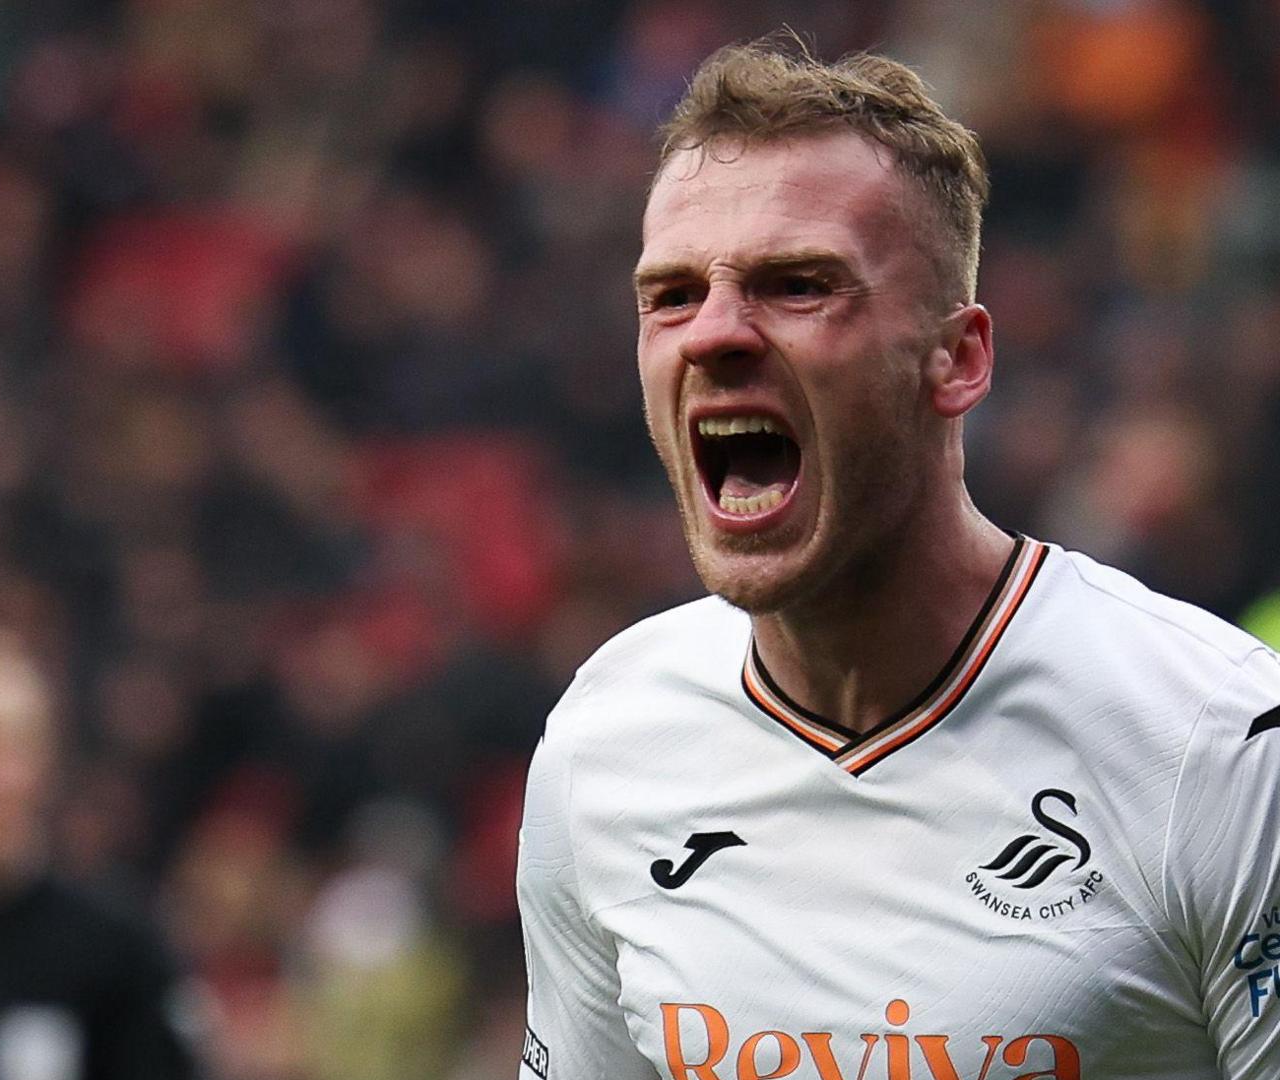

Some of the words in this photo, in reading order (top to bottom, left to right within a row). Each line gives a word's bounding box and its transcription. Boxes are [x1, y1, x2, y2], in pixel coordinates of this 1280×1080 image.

[966, 871, 1032, 920] SWANSEA
[1039, 896, 1075, 919] CITY
[1078, 870, 1103, 903] AFC
